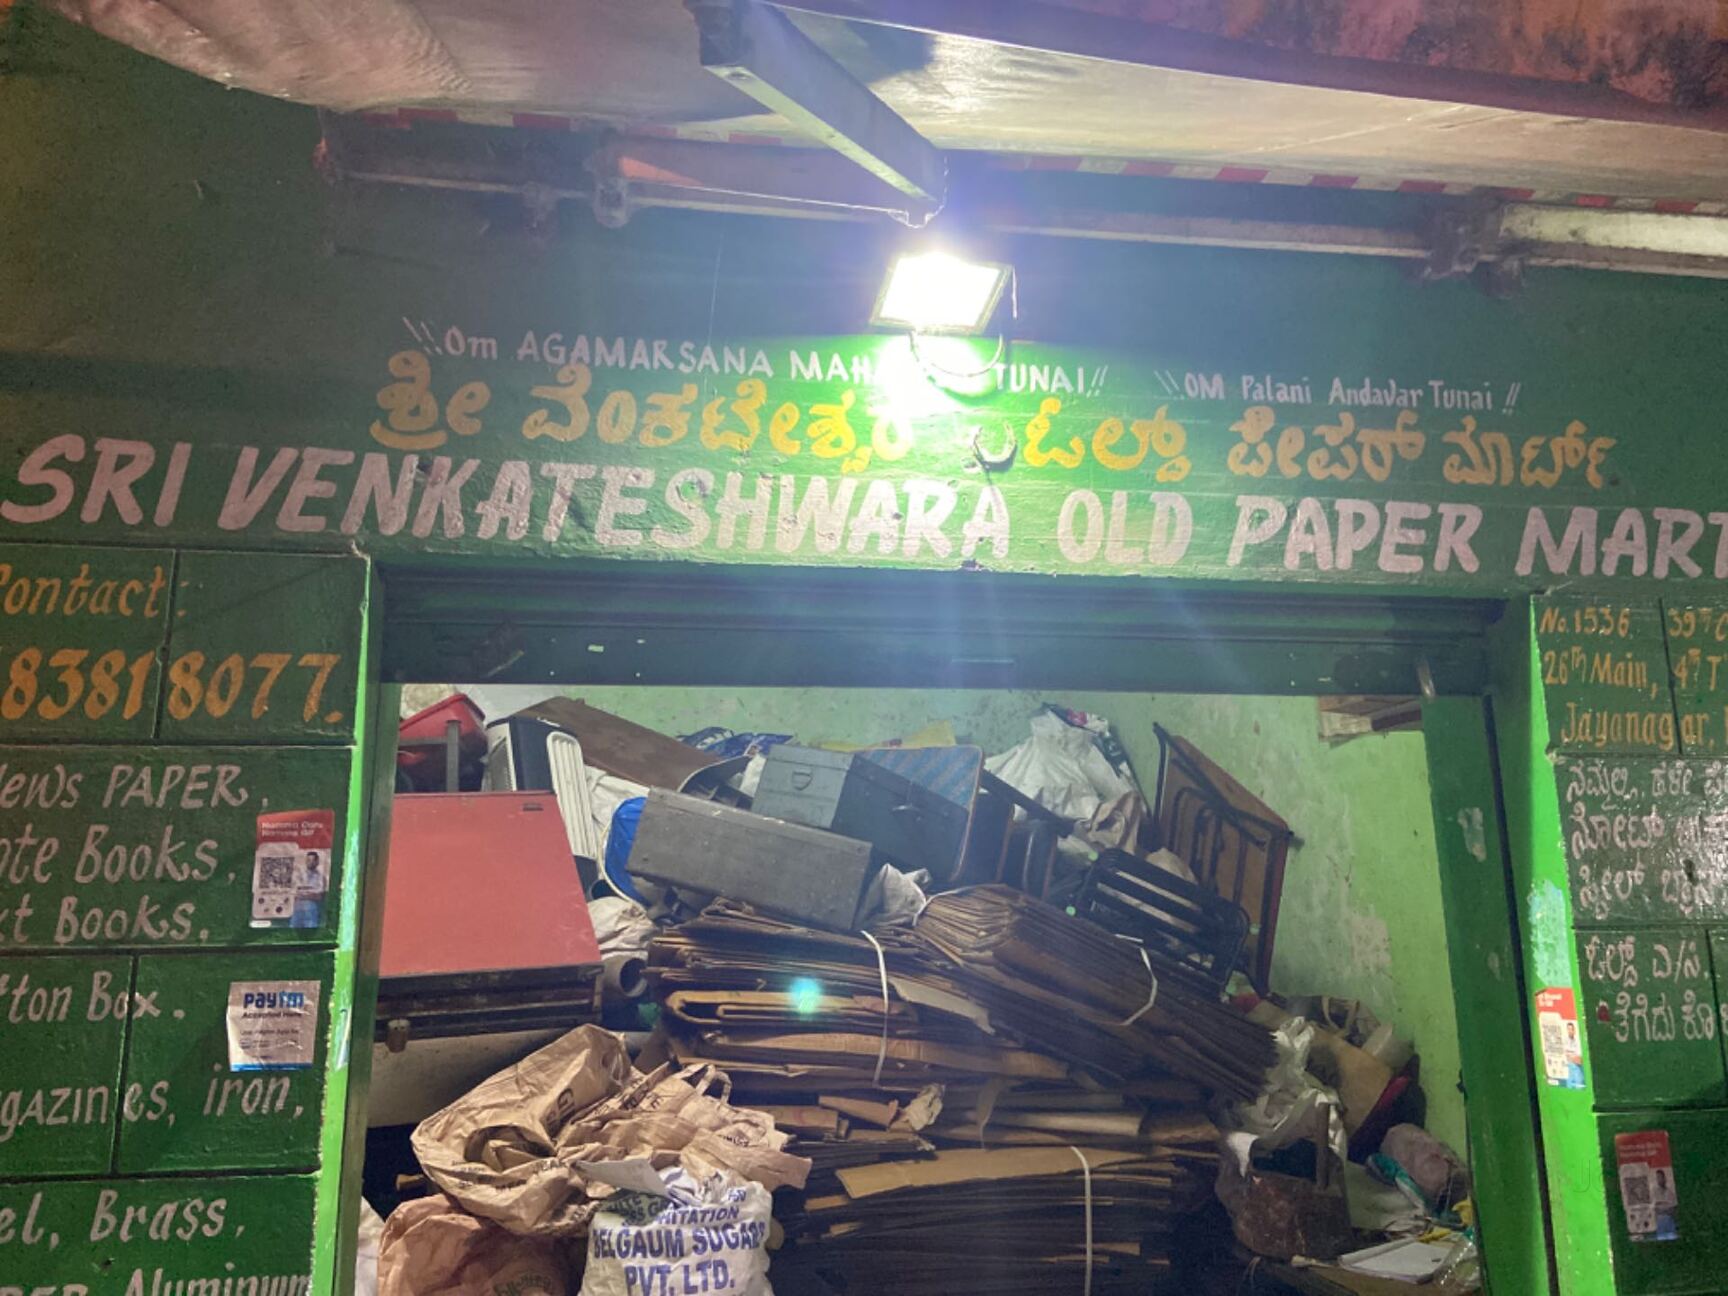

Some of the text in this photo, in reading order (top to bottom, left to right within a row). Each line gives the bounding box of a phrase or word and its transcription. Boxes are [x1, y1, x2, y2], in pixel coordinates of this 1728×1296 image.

[517, 332, 773, 377] AGAMARSANA
[1241, 374, 1313, 404] Palani
[1328, 377, 1424, 408] Andavar
[1428, 380, 1493, 411] Tunai
[369, 350, 491, 451] ಶ್ರೀ
[1227, 405, 1425, 482] ಪೇಪರ್
[0, 434, 192, 527] SRI
[217, 446, 1012, 560] VENKATESHWARA
[1057, 489, 1193, 565] OLD
[1226, 495, 1483, 573] PAPER
[592, 1226, 685, 1260] BELGAUM
[683, 1259, 735, 1295] LTD.
